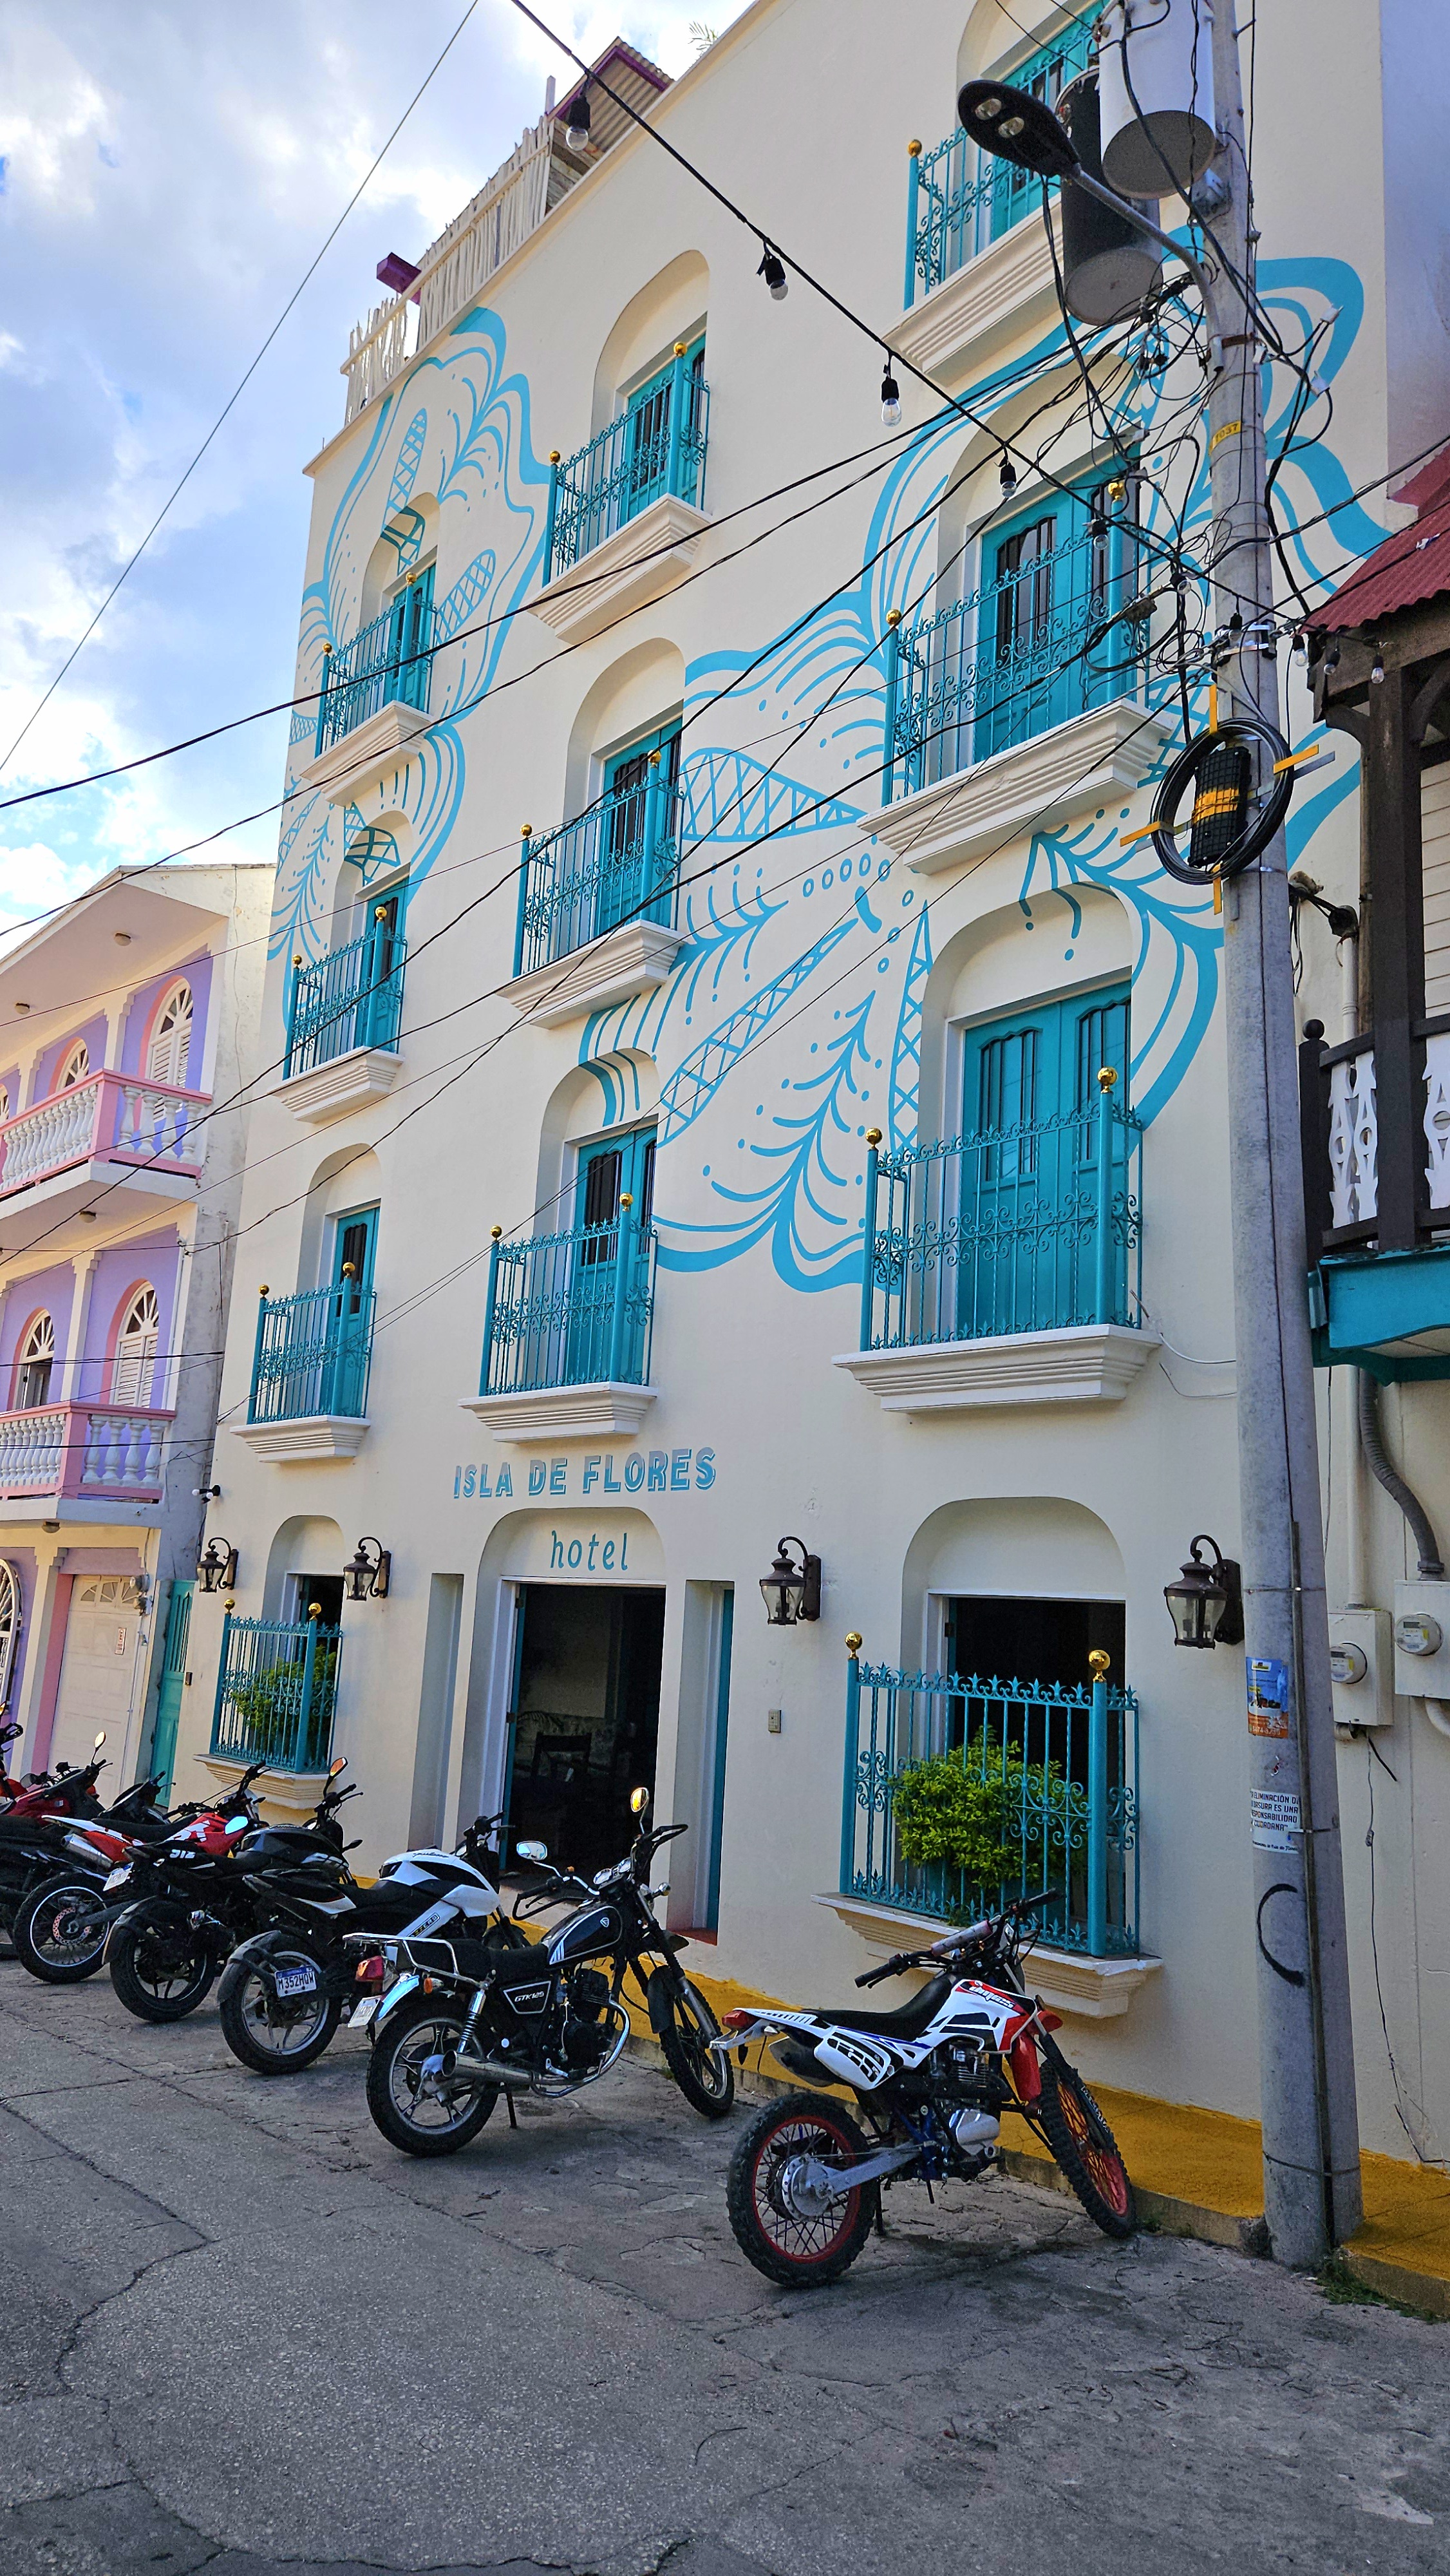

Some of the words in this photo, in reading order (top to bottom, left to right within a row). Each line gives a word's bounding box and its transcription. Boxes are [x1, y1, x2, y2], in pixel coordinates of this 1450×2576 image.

[453, 1461, 514, 1499] ISLA
[528, 1457, 569, 1496] DE
[582, 1446, 717, 1493] FLORES
[550, 1530, 628, 1571] hotel
[1274, 1804, 1282, 1812] ES
[1284, 1805, 1299, 1814] UNA
